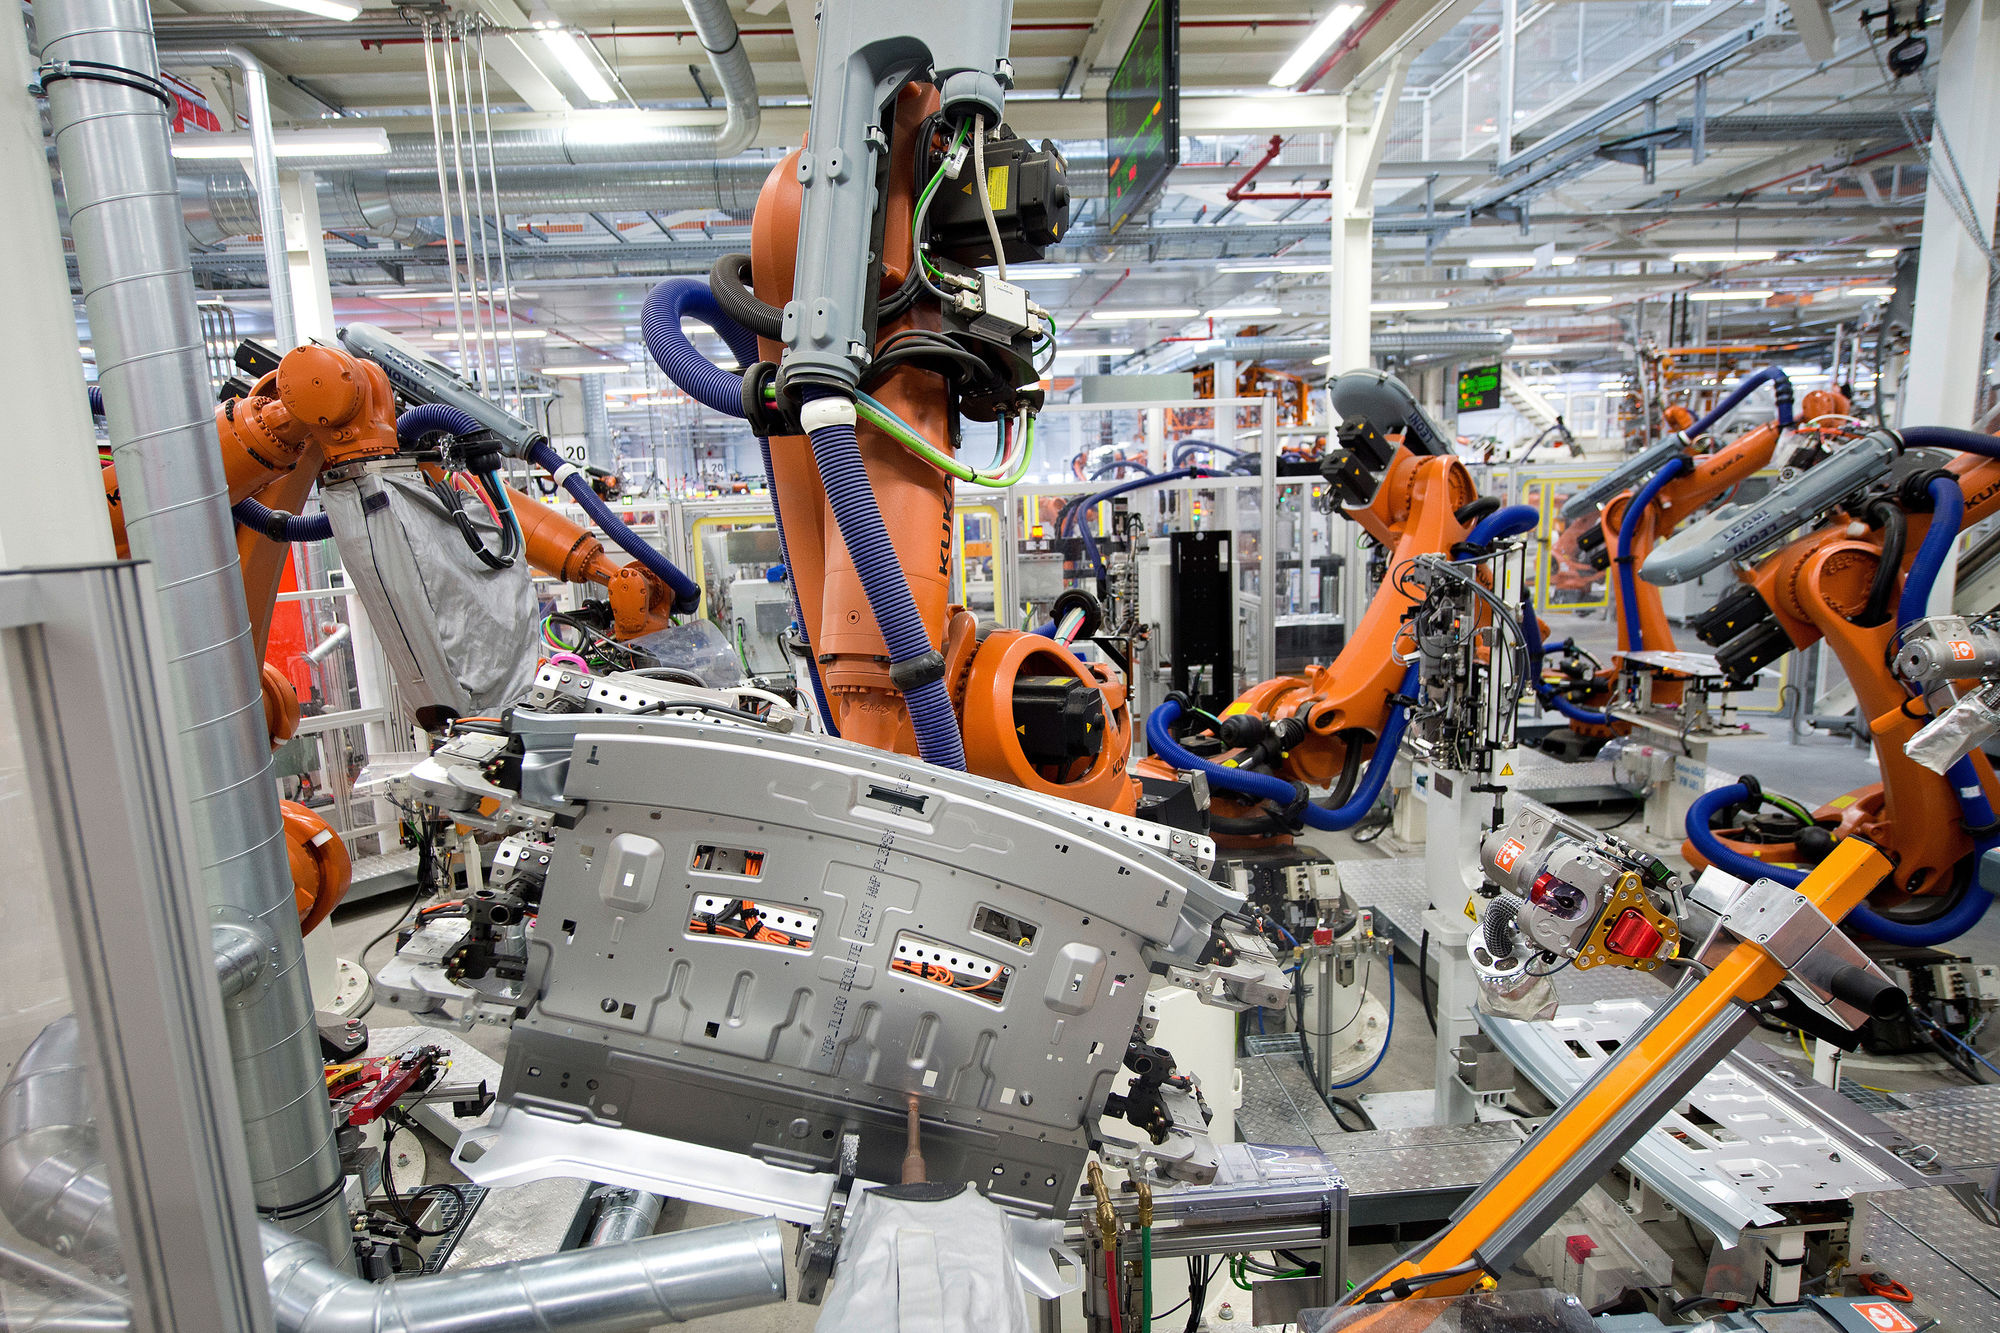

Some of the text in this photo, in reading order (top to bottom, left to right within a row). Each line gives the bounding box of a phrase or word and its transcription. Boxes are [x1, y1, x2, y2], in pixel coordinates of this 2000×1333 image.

[1408, 412, 1433, 443] LEONI
[566, 445, 586, 460] 20
[938, 472, 953, 576] KUKA
[1723, 509, 1771, 542] LEONI
[1733, 522, 1777, 554] LEONI
